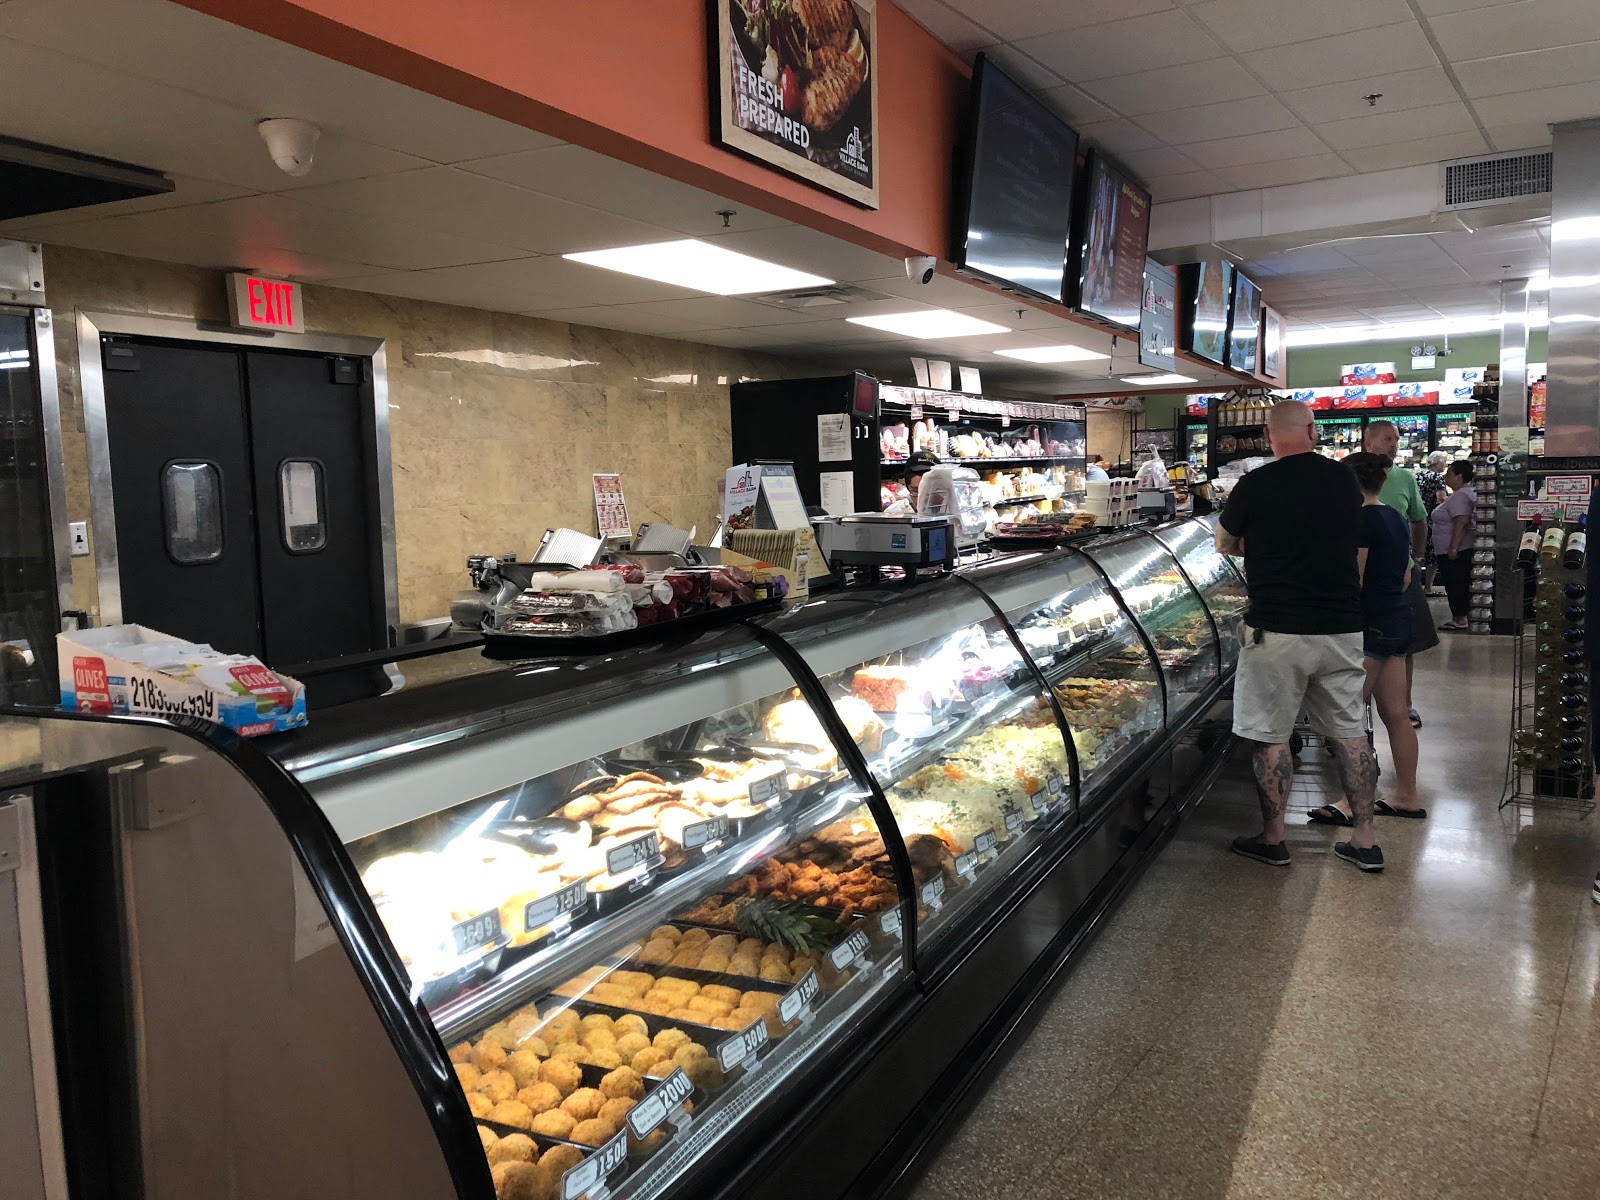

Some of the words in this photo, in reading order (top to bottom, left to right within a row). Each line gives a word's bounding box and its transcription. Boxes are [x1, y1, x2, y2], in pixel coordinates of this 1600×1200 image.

[739, 65, 784, 110] FRESH
[741, 93, 810, 149] PREPARED
[839, 151, 857, 168] VILLAGE
[857, 160, 869, 173] BARN
[247, 277, 293, 328] EXIT
[76, 668, 105, 689] OLIVES
[238, 671, 279, 687] OLIVES
